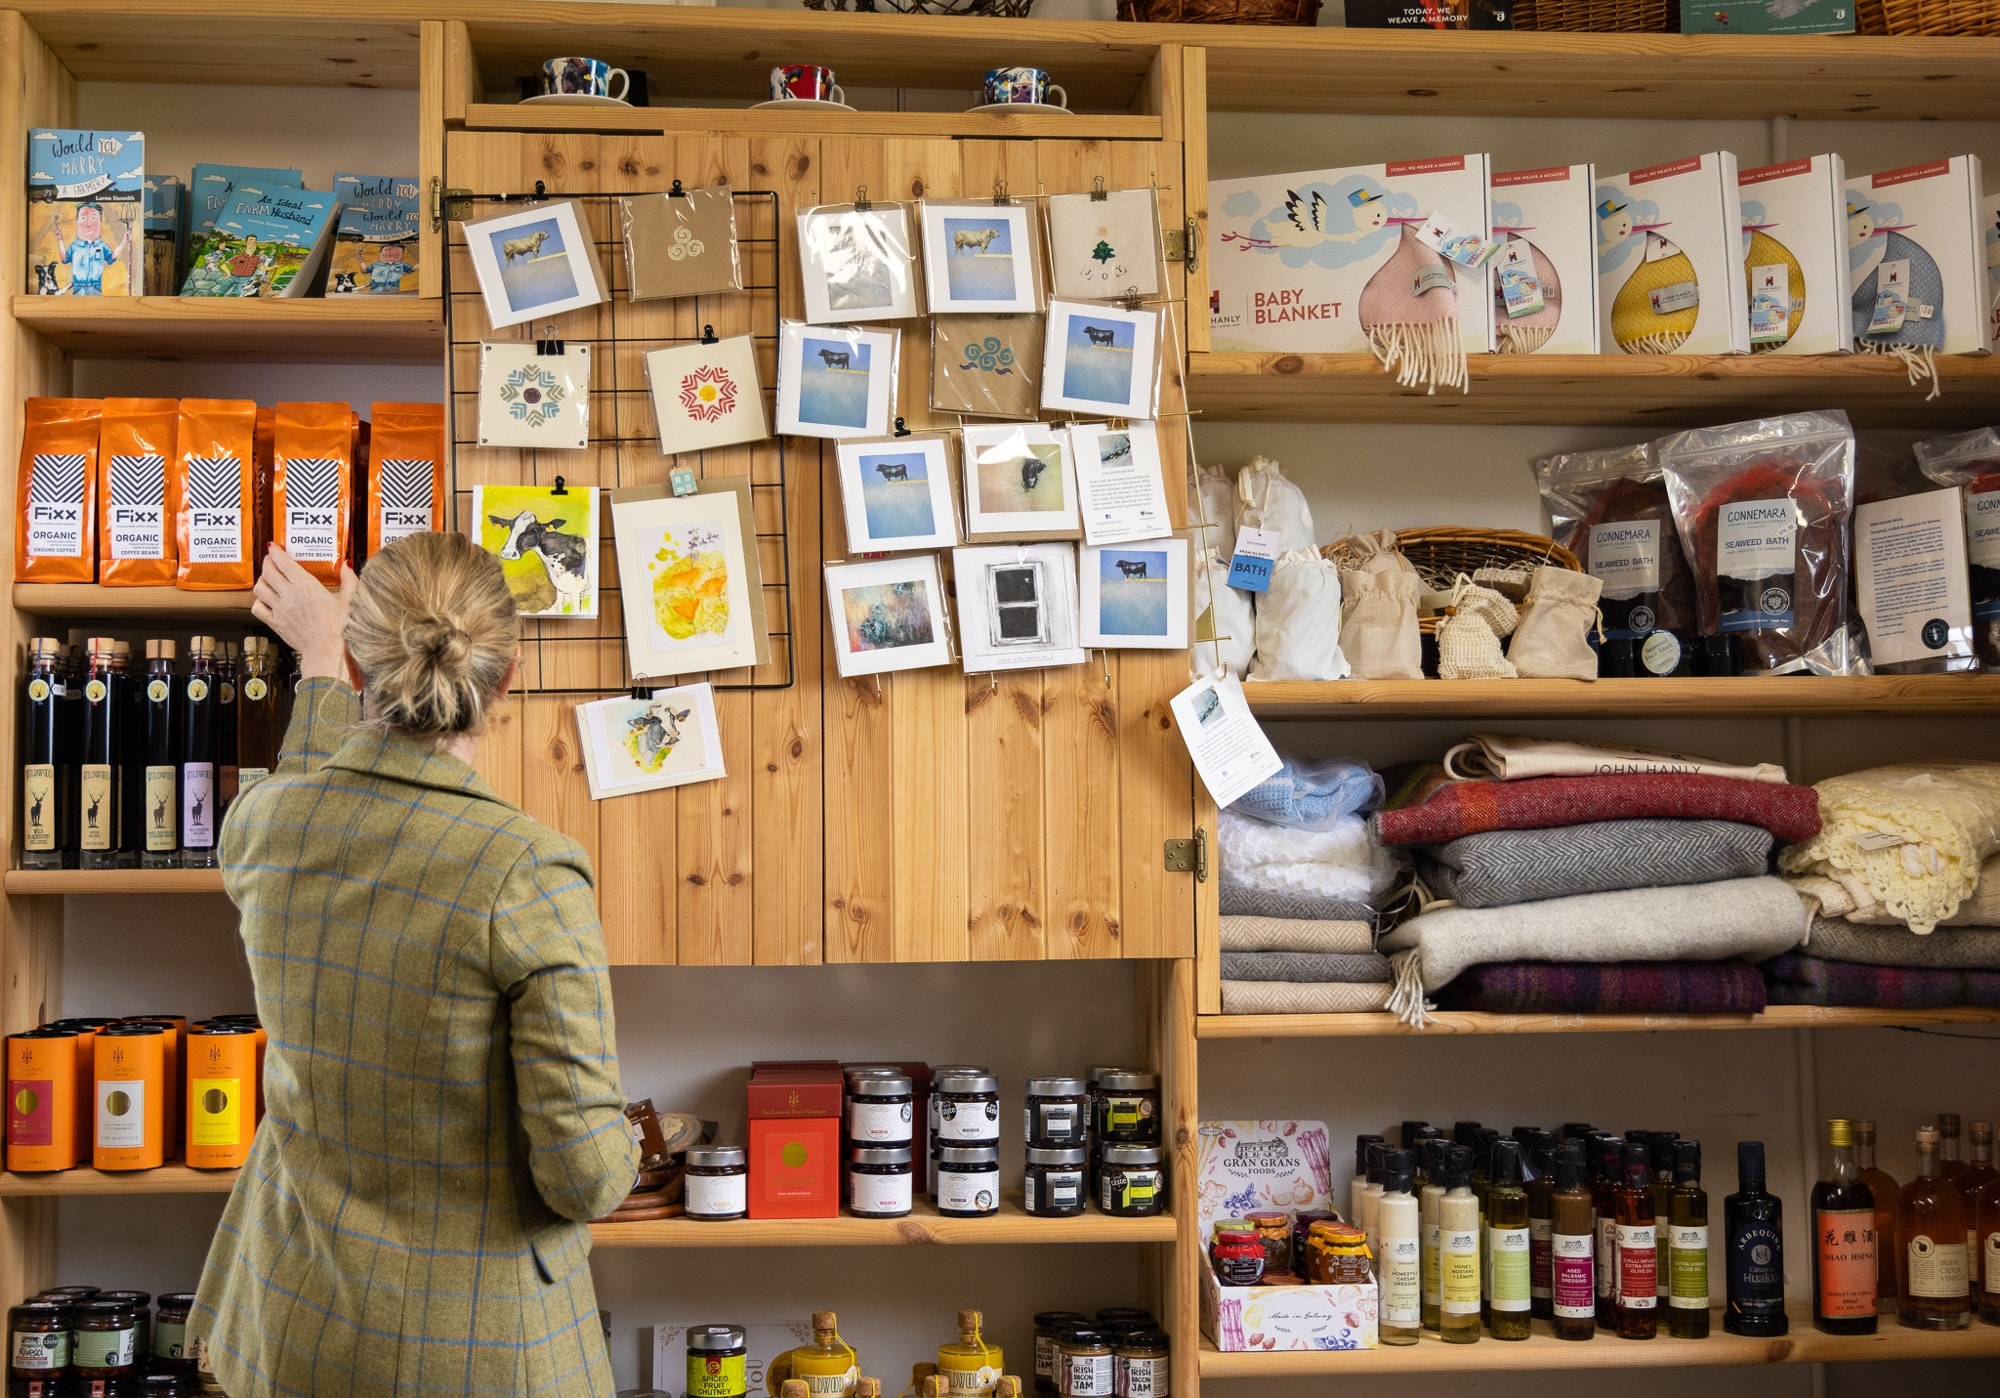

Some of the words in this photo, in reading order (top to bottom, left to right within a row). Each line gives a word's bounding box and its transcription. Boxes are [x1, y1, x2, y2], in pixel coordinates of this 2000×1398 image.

[1403, 8, 1435, 16] TODAY,
[1428, 15, 1468, 23] MEMORY
[52, 132, 94, 158] Would
[99, 139, 117, 153] YOU
[62, 156, 105, 175] MARRY
[1657, 167, 1672, 175] WEAVE
[1677, 162, 1697, 170] MEMORY
[1924, 166, 1945, 174] MEMORY
[73, 177, 106, 195] FARMER?
[354, 178, 393, 198] Would
[397, 185, 414, 198] YOU
[258, 195, 272, 204] An
[276, 198, 304, 210] Ideal
[235, 203, 271, 216] FARM
[271, 207, 314, 226] Husband
[363, 210, 403, 222] Would
[370, 221, 411, 231] MARRY
[1254, 288, 1304, 308] BABY
[1662, 294, 1675, 302] JOHN
[1675, 290, 1692, 298] HANLY
[1255, 302, 1342, 325] BLANKET
[1211, 315, 1240, 325] HANLY
[34, 506, 77, 521] Fixx
[116, 509, 158, 523] Fixx
[194, 513, 236, 526] Fixx
[291, 511, 333, 525] Fixx
[385, 511, 426, 525] Fixx
[1728, 508, 1787, 523] CONNEMARA
[33, 531, 77, 540] ORGANIC
[115, 534, 159, 543] ORGANIC
[193, 537, 237, 546] ORGANIC
[290, 536, 333, 545] ORGANIC
[1597, 529, 1651, 544] CONNEMARA
[1725, 538, 1762, 549] SEAWEED
[1765, 537, 1789, 545] BATH
[1595, 558, 1630, 569] SEAWEED
[1632, 557, 1653, 566] BATH
[1234, 562, 1267, 577] BATH
[1645, 637, 1668, 654] Seaweed
[1658, 643, 1673, 656] Mask
[1591, 764, 1638, 775] JOHN
[1223, 1158, 1257, 1168] GRAN
[1260, 1158, 1300, 1167] GRANS
[1738, 1229, 1781, 1251] ARBEQUINA
[1824, 1254, 1848, 1262] SHAO
[1851, 1252, 1875, 1261] HSING
[1073, 1366, 1093, 1374] IRISH
[1131, 1368, 1151, 1376] IRISH
[701, 1375, 729, 1383] SPICED
[1073, 1381, 1093, 1390] JAM
[1131, 1383, 1151, 1392] JAM
[698, 1388, 732, 1396] CHUTNEY
